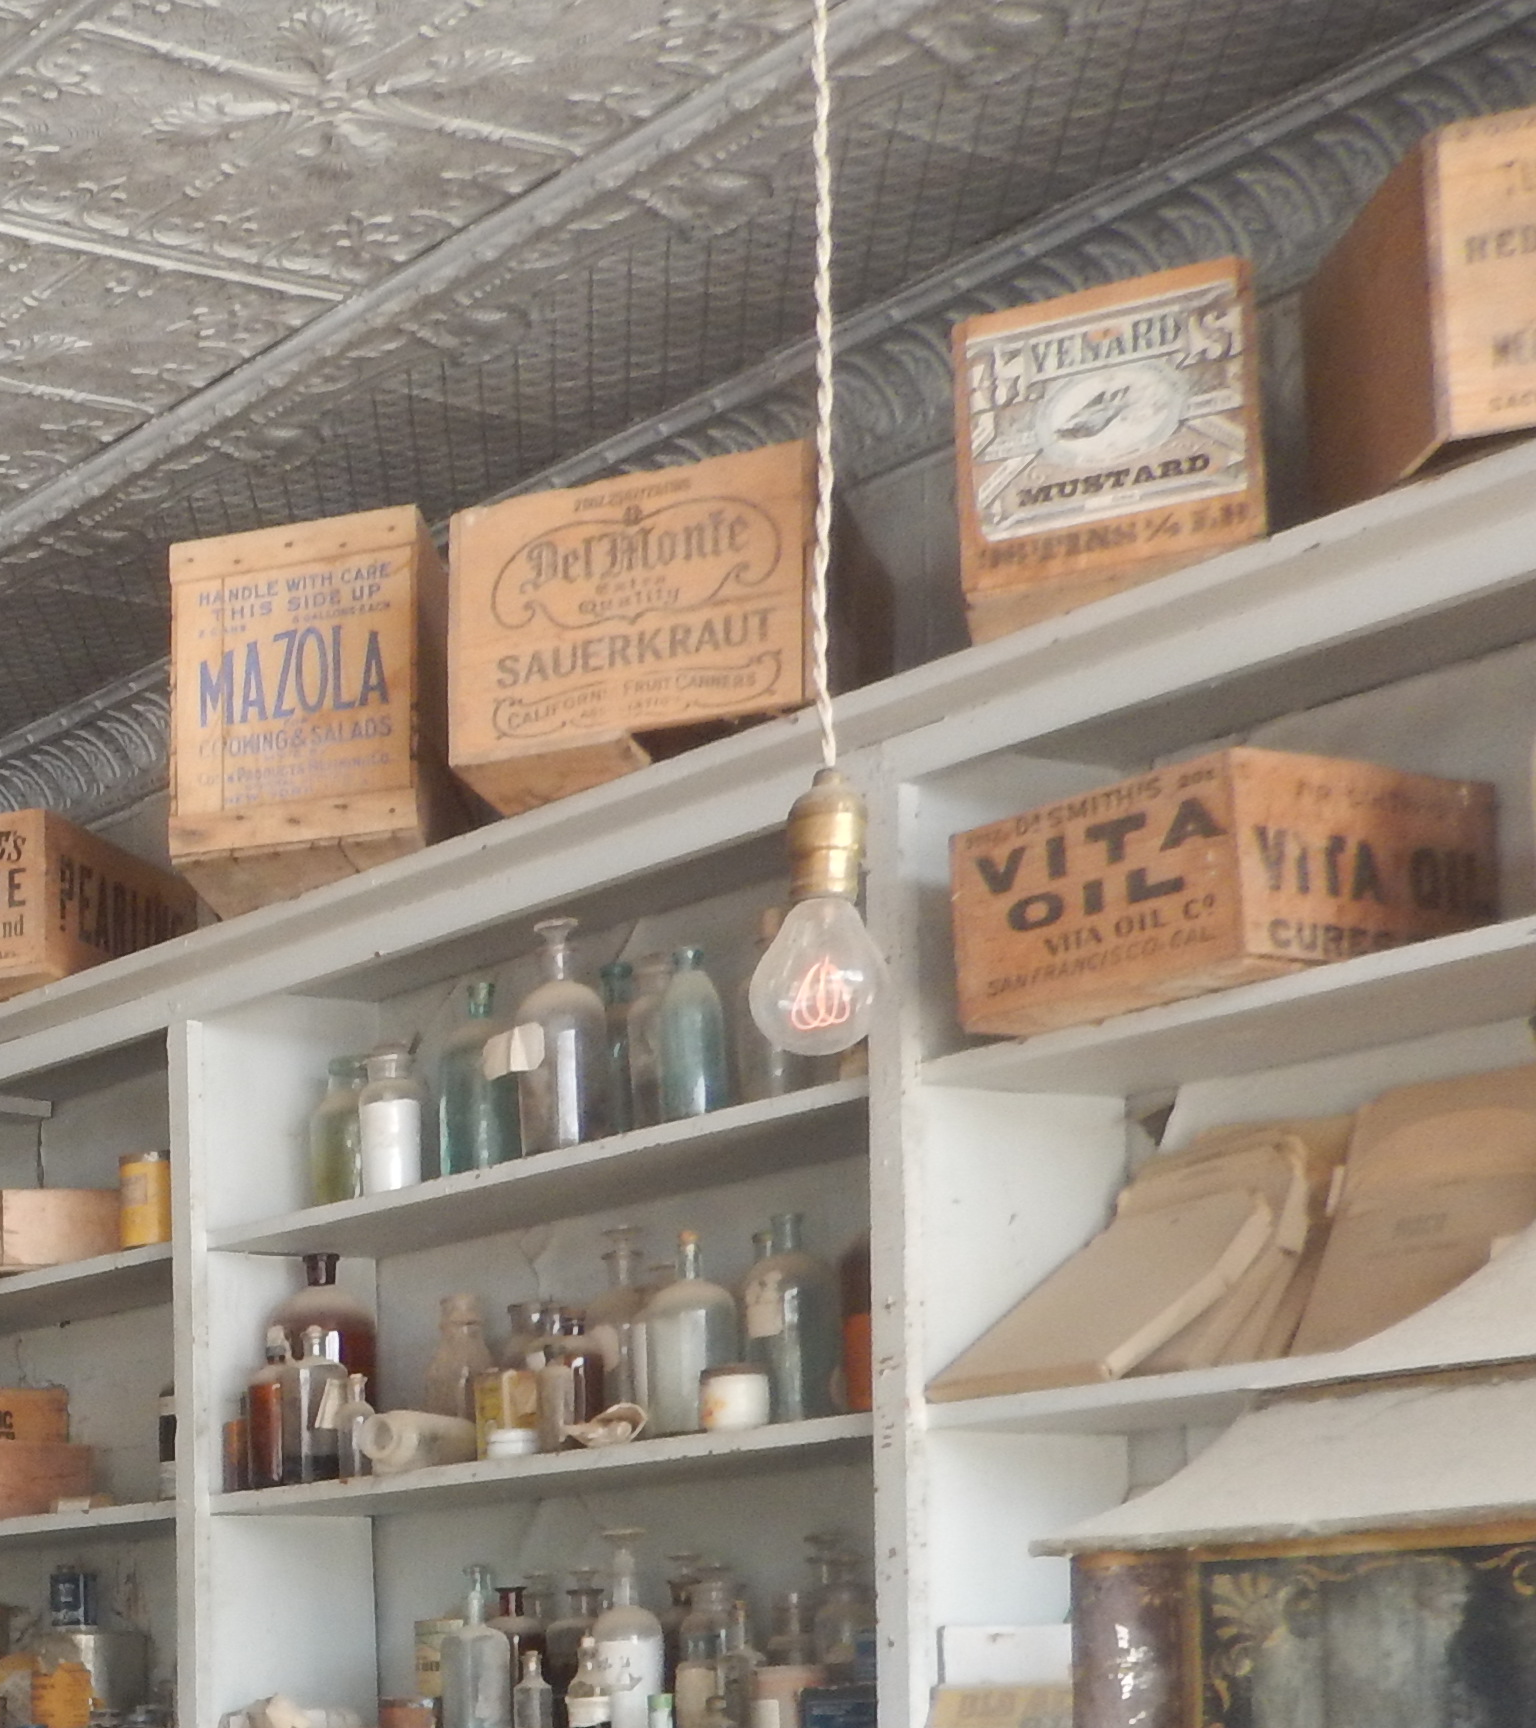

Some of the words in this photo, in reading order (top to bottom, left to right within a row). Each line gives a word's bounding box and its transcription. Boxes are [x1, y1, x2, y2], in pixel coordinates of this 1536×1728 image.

[1016, 453, 1211, 508] MUSTARD
[199, 580, 279, 607] HANDLE
[286, 572, 333, 593] WITH
[340, 562, 391, 585] CARE
[211, 600, 273, 622] THIS
[287, 589, 342, 612] SIDE
[352, 583, 382, 601] UP
[199, 625, 390, 729] MAZOLA
[496, 606, 778, 690] SAUERKRAUT
[309, 714, 393, 743] SALADS
[975, 797, 1229, 896] VITA
[1254, 825, 1390, 905] VITA
[1006, 866, 1185, 932] OIL
[1043, 925, 1103, 956] VITA
[1114, 908, 1167, 938] OIL
